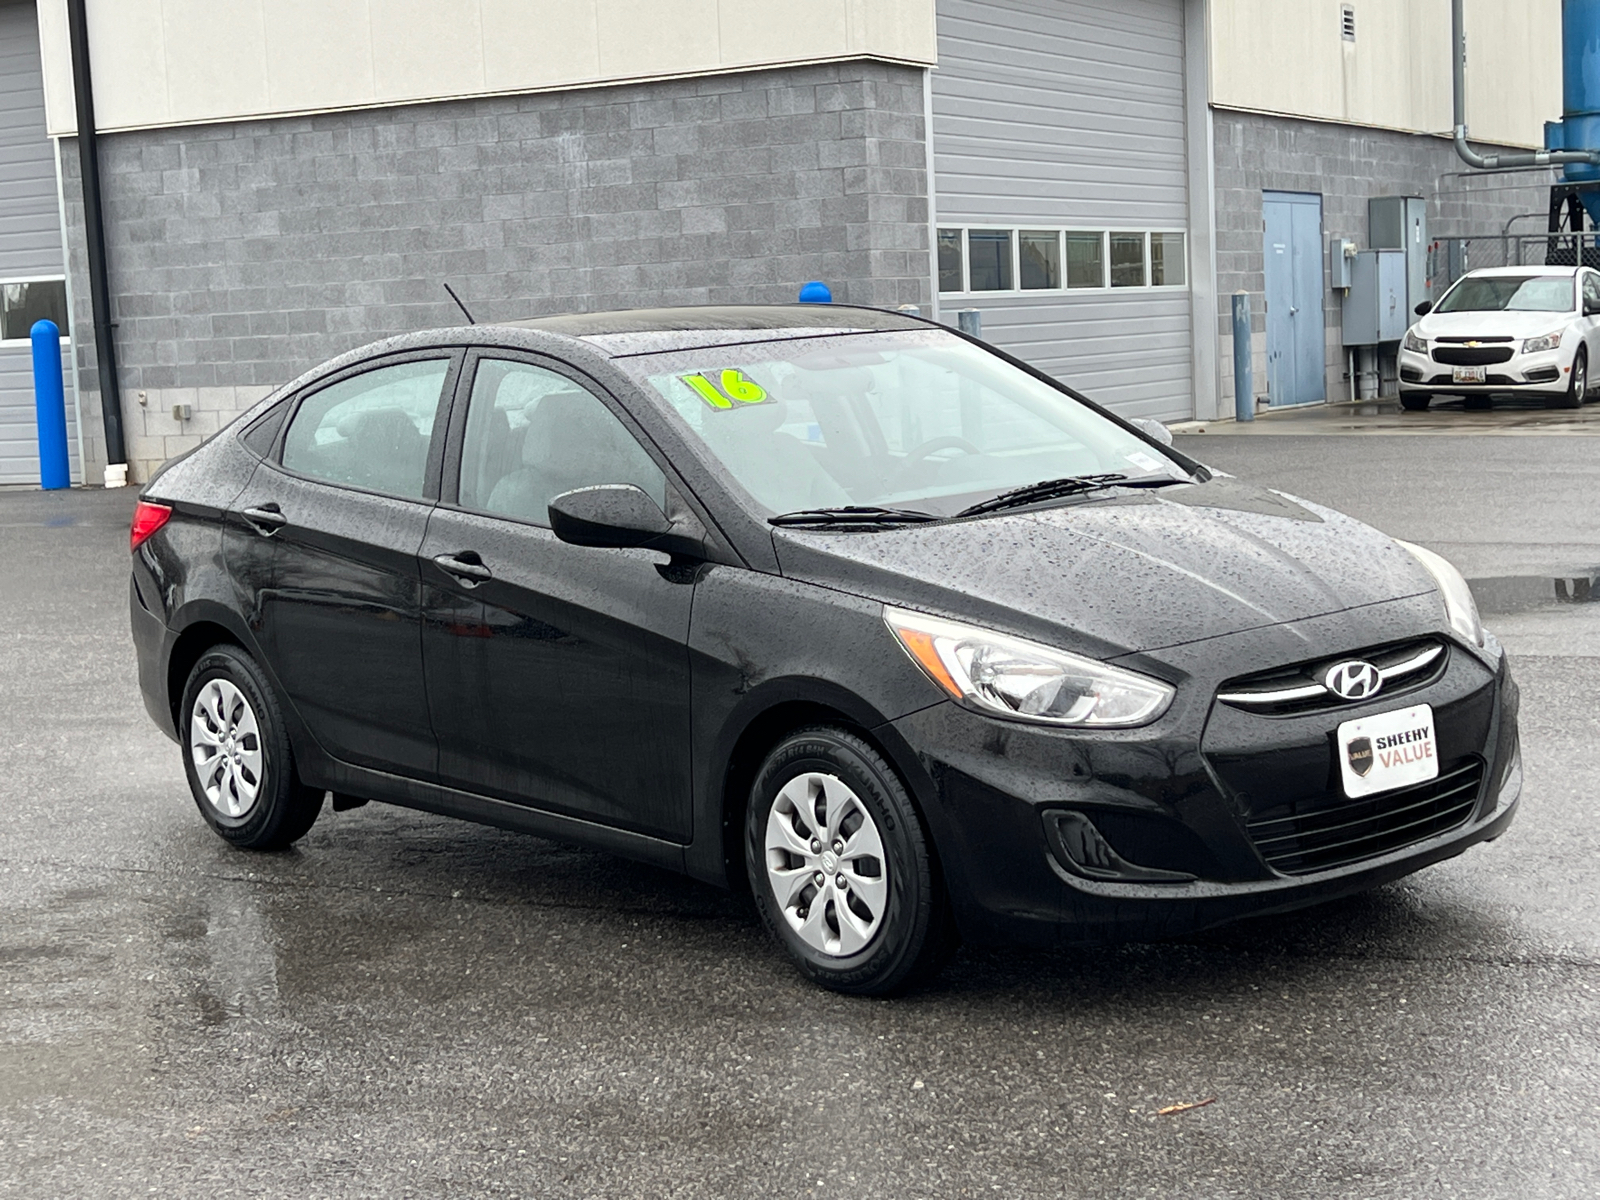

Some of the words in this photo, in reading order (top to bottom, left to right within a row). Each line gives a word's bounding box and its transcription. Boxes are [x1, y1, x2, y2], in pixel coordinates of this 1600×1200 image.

[682, 369, 768, 409] 16
[1376, 726, 1429, 750] SHEEHY
[1349, 749, 1372, 761] VALUE
[1379, 741, 1433, 768] VALUE
[847, 761, 896, 832] KUMHO
